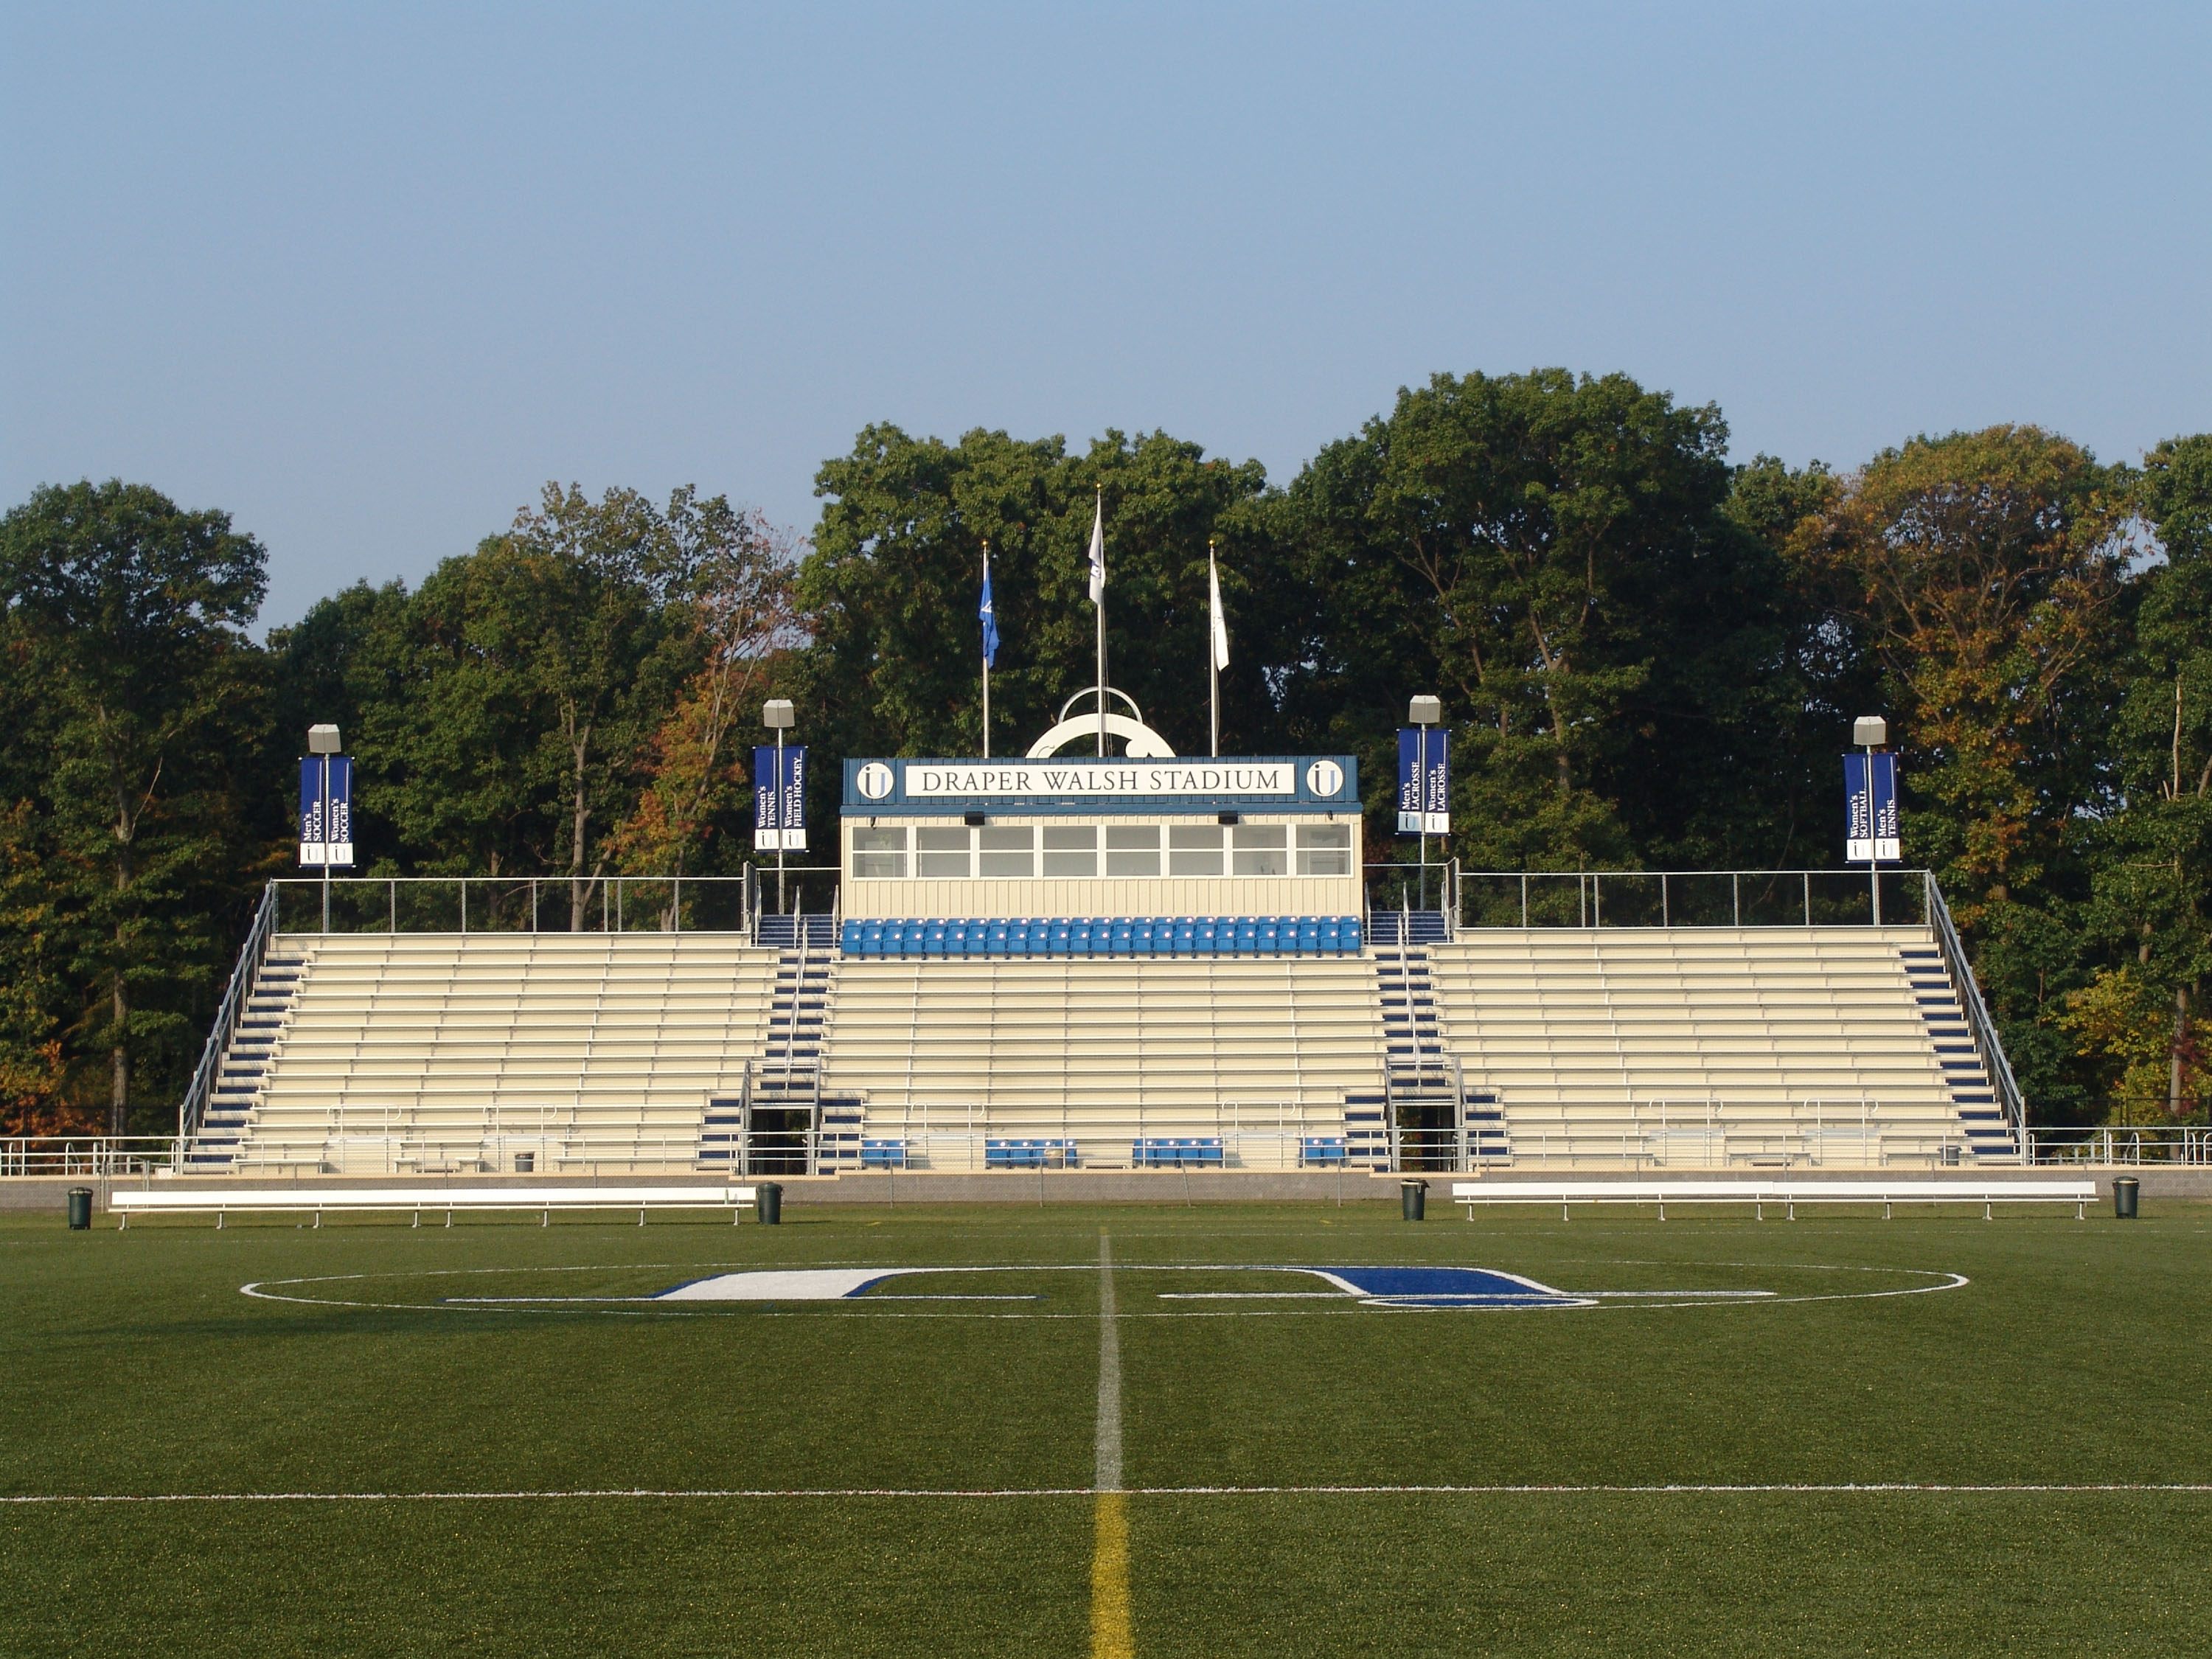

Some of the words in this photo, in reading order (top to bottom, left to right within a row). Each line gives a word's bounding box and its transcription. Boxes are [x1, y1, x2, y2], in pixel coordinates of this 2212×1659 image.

[793, 757, 802, 798] HOCKEY
[922, 772, 1032, 790] DRAPER
[1043, 771, 1138, 790] WALSH
[1150, 770, 1279, 790] STADIUM
[1402, 783, 1411, 810] Men's
[1428, 770, 1436, 811] Women's
[1437, 763, 1445, 811] LACROSSE
[313, 801, 321, 841] SOCCER
[331, 798, 339, 841] Women's
[341, 802, 349, 843] SOCCER
[758, 785, 766, 828] Women's
[768, 791, 776, 827] TENNIS
[785, 785, 793, 827] Women's
[793, 799, 802, 827] FIELD
[1850, 795, 1858, 838] Women's
[1860, 789, 1868, 838] SOFTBALL
[1878, 809, 1887, 837] Men's
[1888, 799, 1896, 836] TENNIS
[304, 813, 312, 841] Men's
